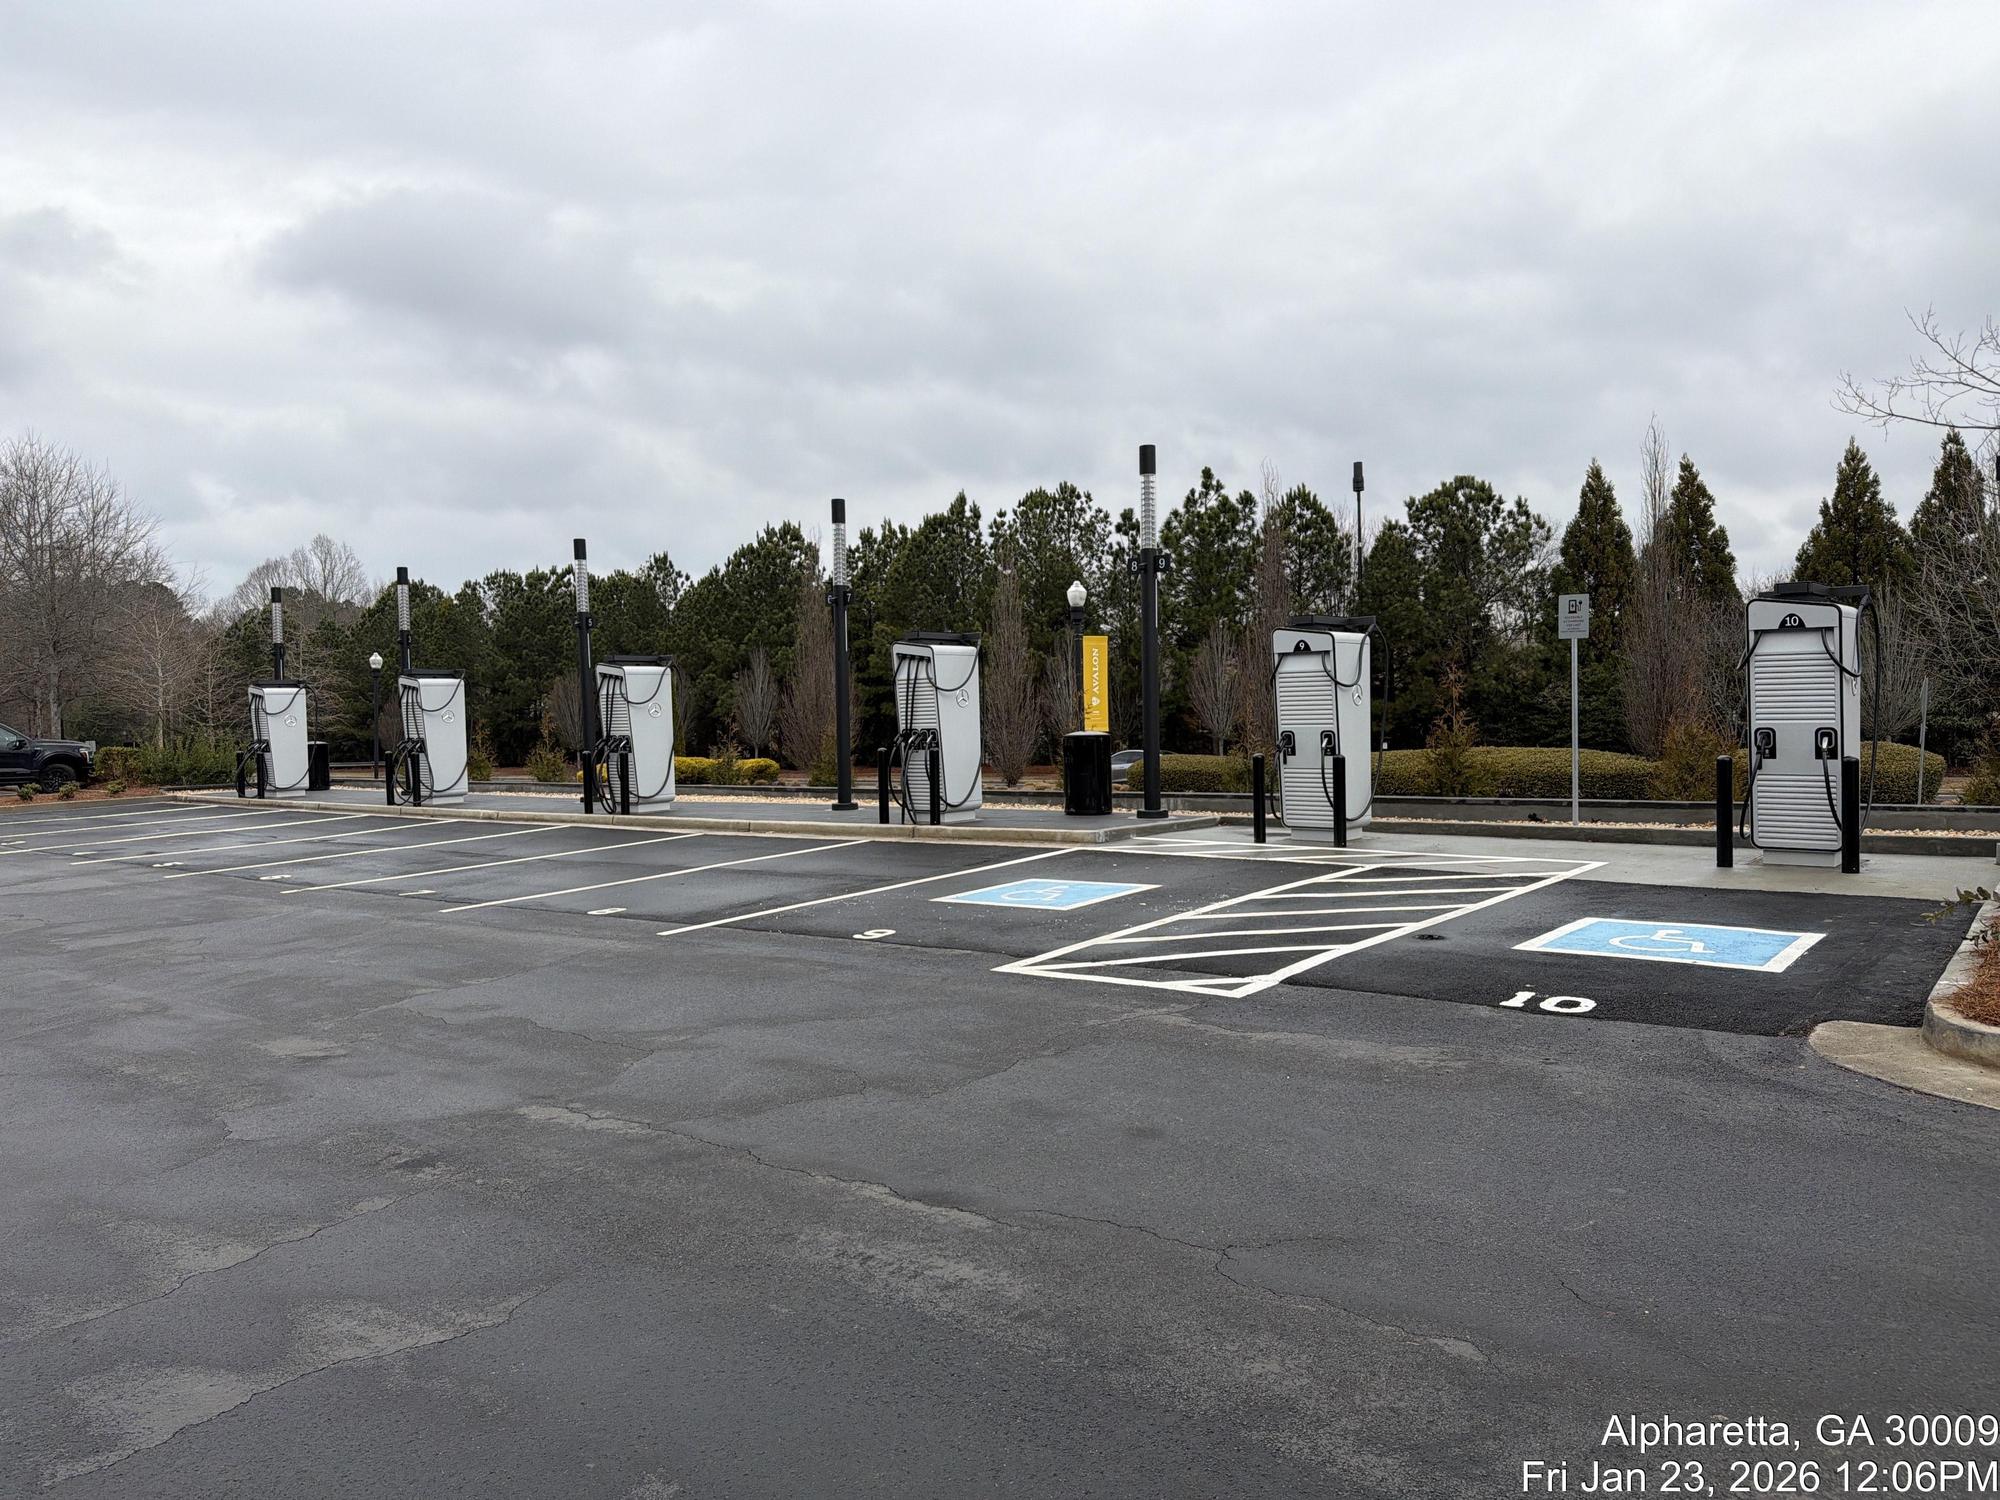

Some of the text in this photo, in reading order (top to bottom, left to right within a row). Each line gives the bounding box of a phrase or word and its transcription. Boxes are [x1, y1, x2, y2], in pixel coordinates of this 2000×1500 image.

[1131, 560, 1138, 572] 8
[1158, 557, 1166, 569] 9
[846, 592, 852, 603] 7
[1784, 615, 1799, 627] 10
[1299, 641, 1305, 651] 9
[1091, 647, 1100, 696] AVALON
[852, 929, 897, 940] 9
[1499, 991, 1598, 1013] 10
